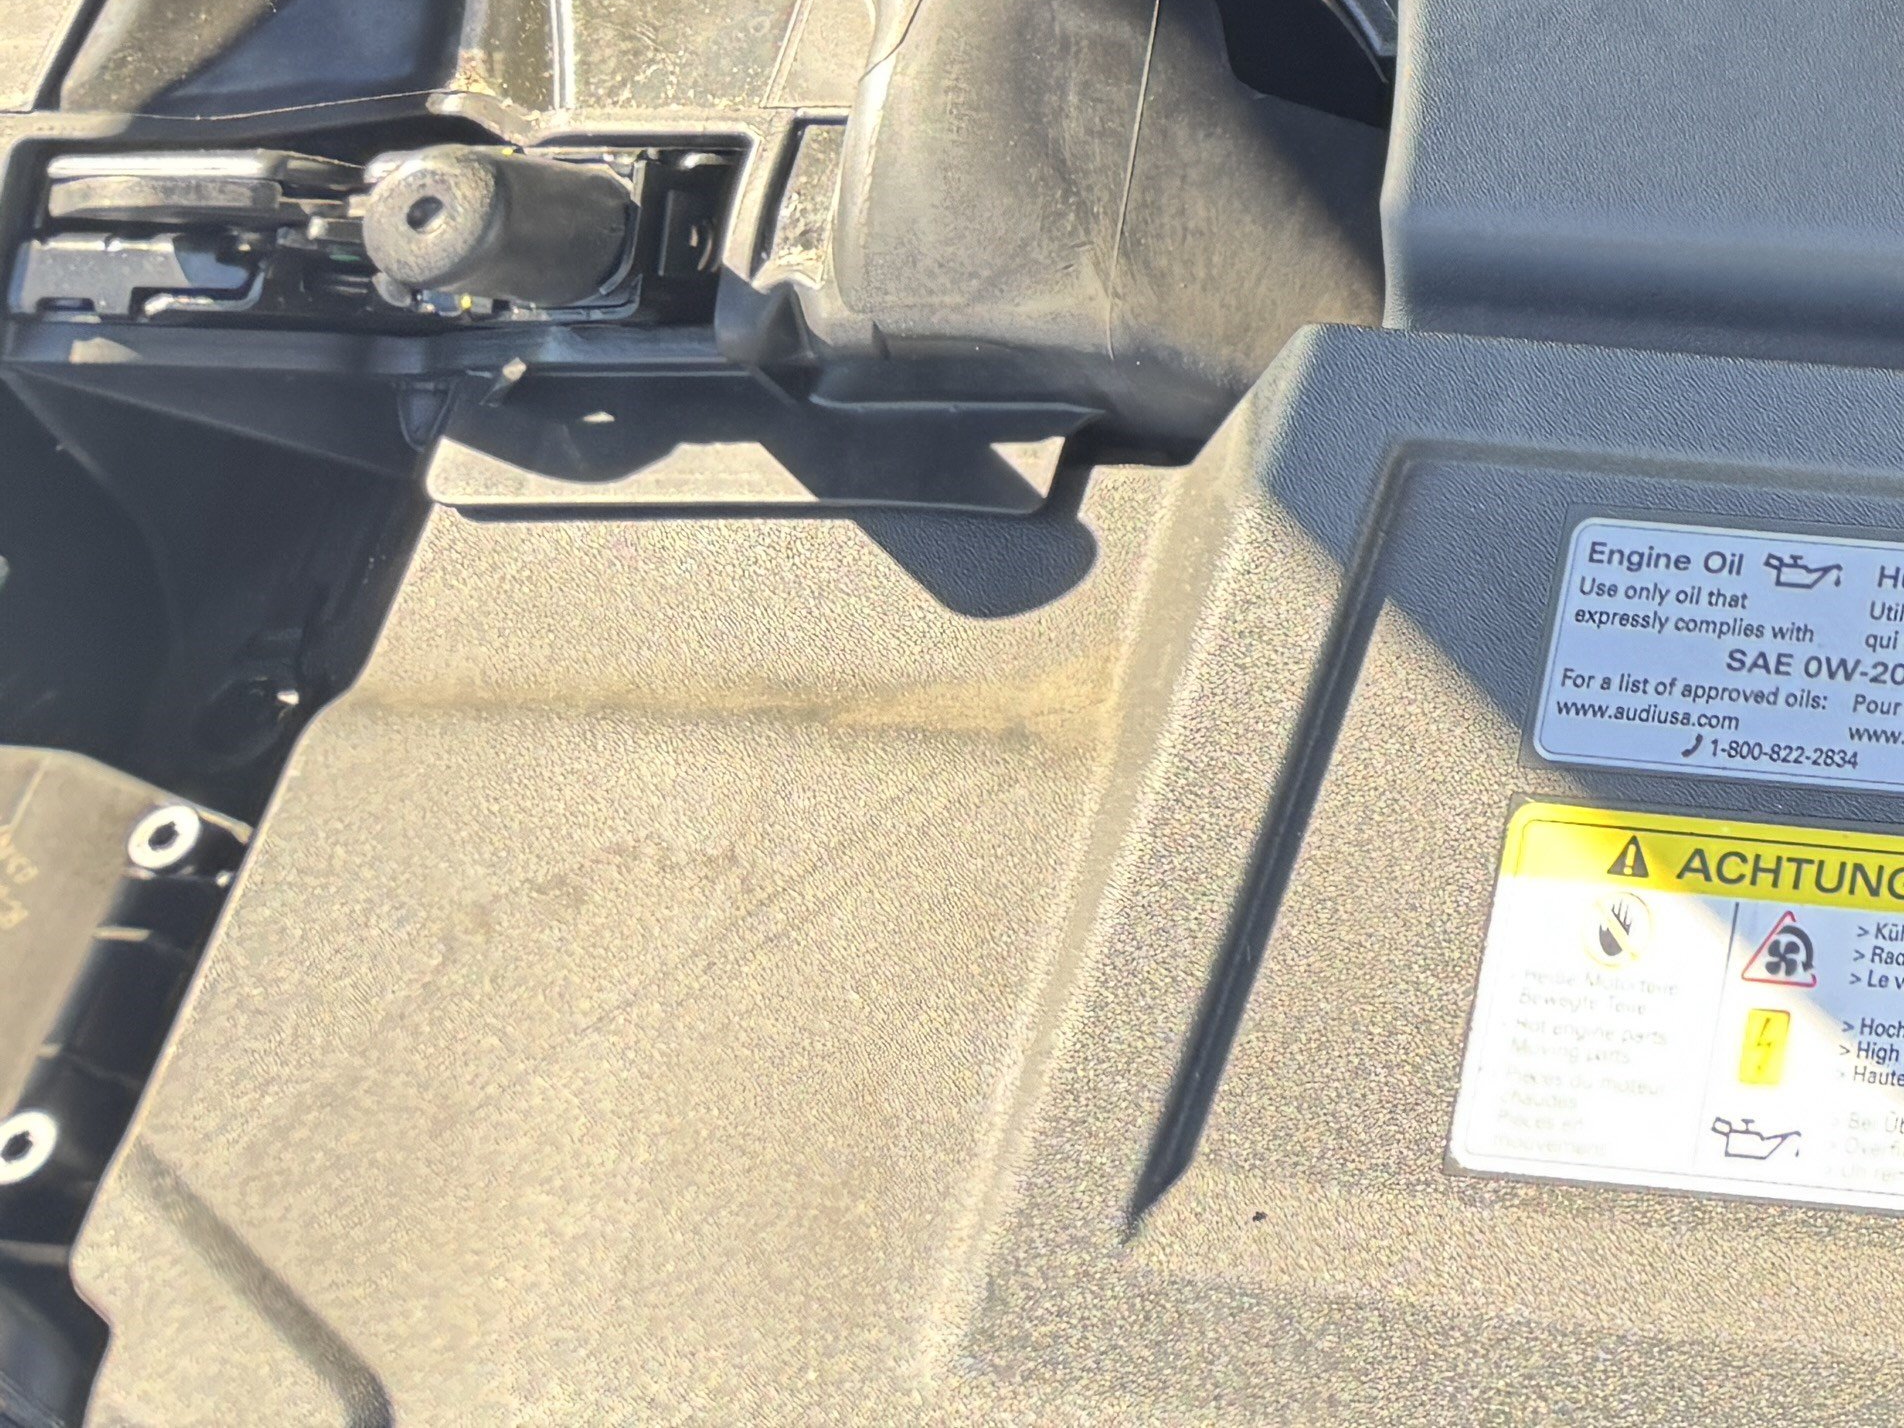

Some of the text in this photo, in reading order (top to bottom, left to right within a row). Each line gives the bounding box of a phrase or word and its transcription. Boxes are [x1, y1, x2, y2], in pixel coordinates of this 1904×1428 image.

[1587, 541, 1744, 576] Engine Oil
[1579, 576, 1748, 610] Use only oil that
[1574, 608, 1814, 643] expressly complies with
[1864, 630, 1899, 653] qui
[1725, 648, 1794, 676] SAE
[1560, 667, 1828, 710] For a list of approved oils:
[1556, 700, 1739, 731] www.audiusa.com
[1852, 693, 1903, 716] Pour
[1710, 738, 1858, 769] 1-800-822-2834
[1866, 968, 1889, 988] Le
[1856, 1039, 1900, 1067] High
